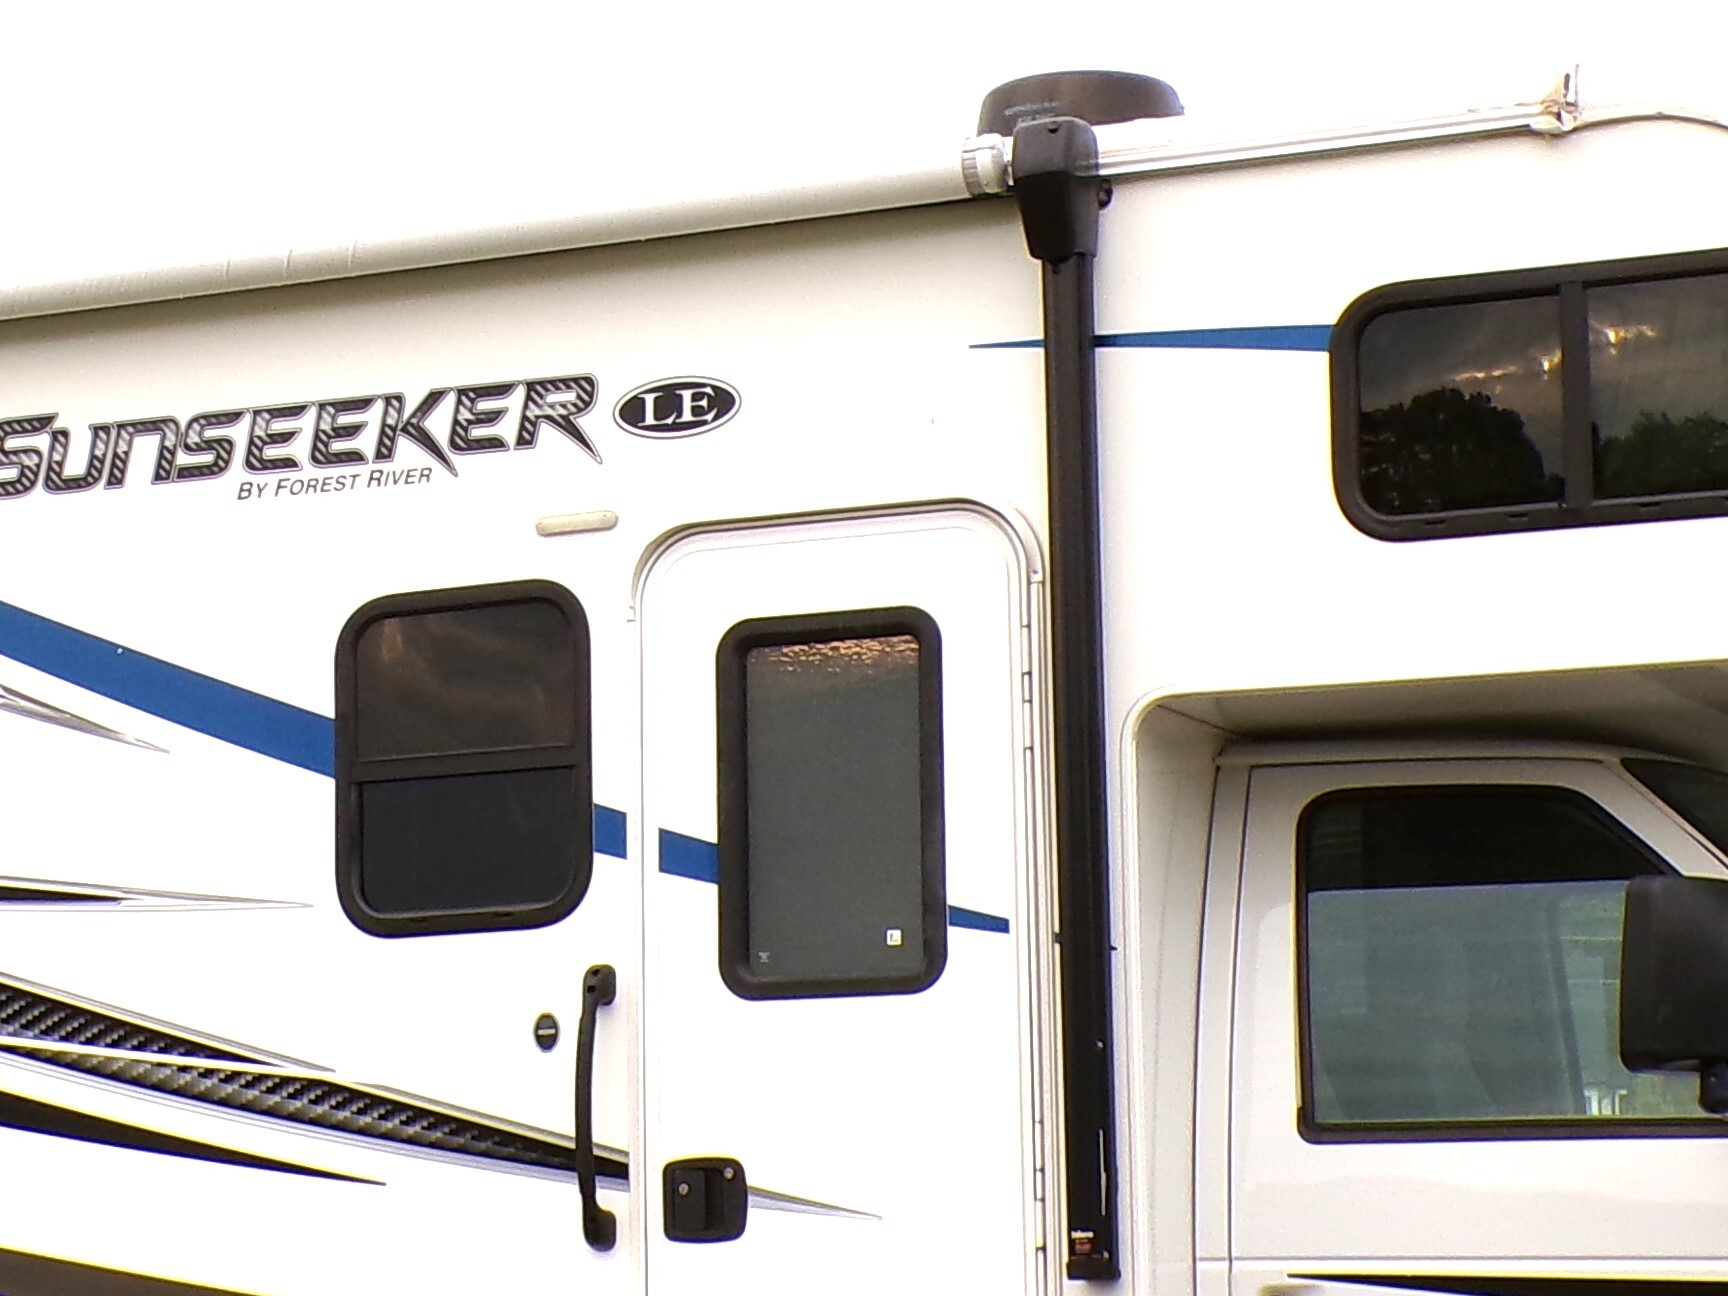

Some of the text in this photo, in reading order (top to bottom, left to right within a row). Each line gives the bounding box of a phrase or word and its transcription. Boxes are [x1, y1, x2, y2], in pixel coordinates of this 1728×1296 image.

[636, 385, 718, 427] LE
[237, 466, 432, 501] BY FOREST RIVER
